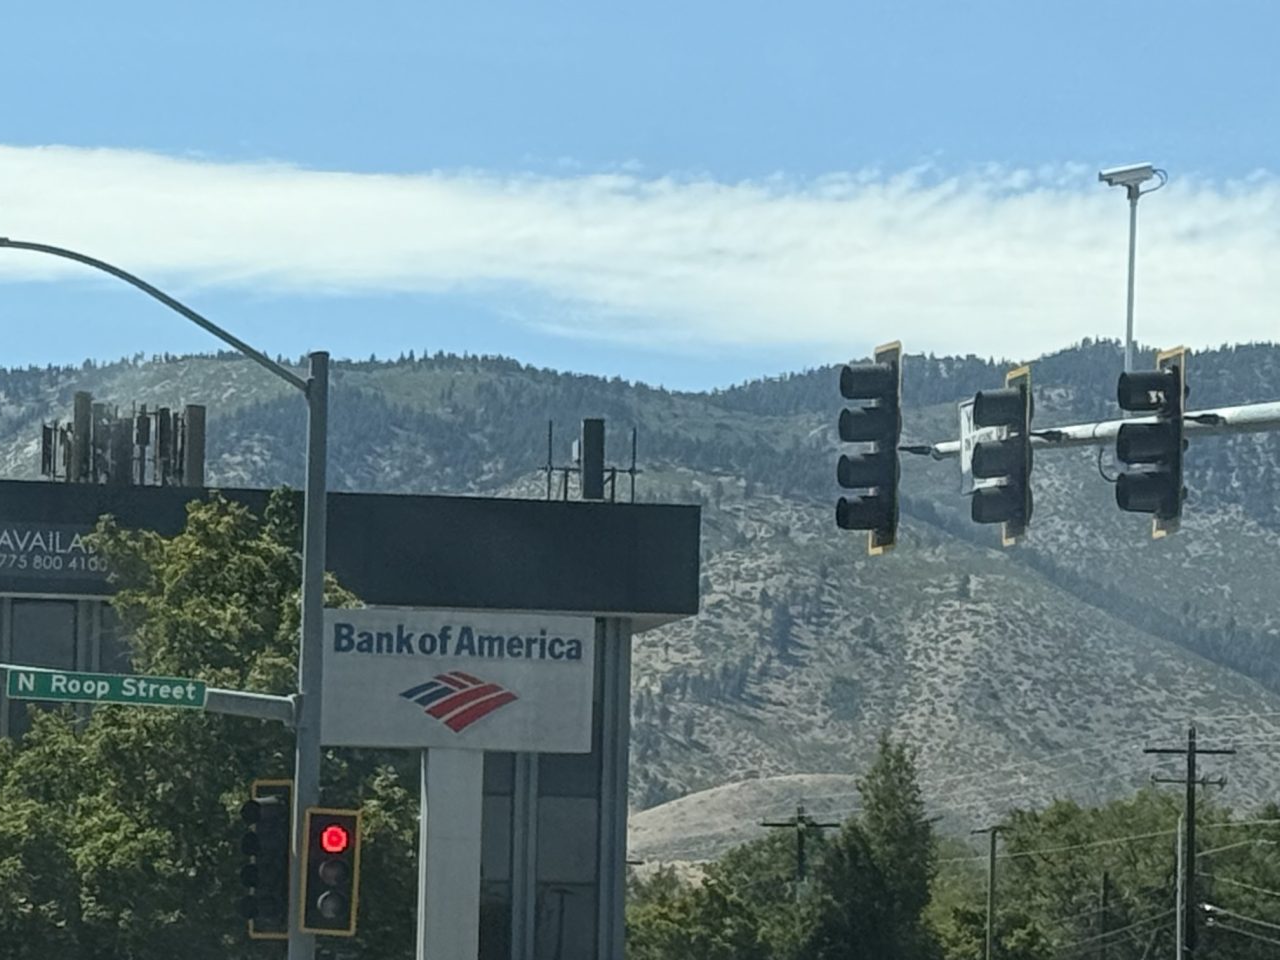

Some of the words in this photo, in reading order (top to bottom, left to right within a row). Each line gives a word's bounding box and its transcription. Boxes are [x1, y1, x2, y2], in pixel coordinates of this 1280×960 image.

[33, 555, 62, 570] 800
[333, 623, 415, 654] Bank
[419, 626, 452, 656] of
[454, 626, 583, 660] America
[18, 673, 34, 691] N
[51, 675, 110, 698] Roop
[122, 678, 196, 700] Street
